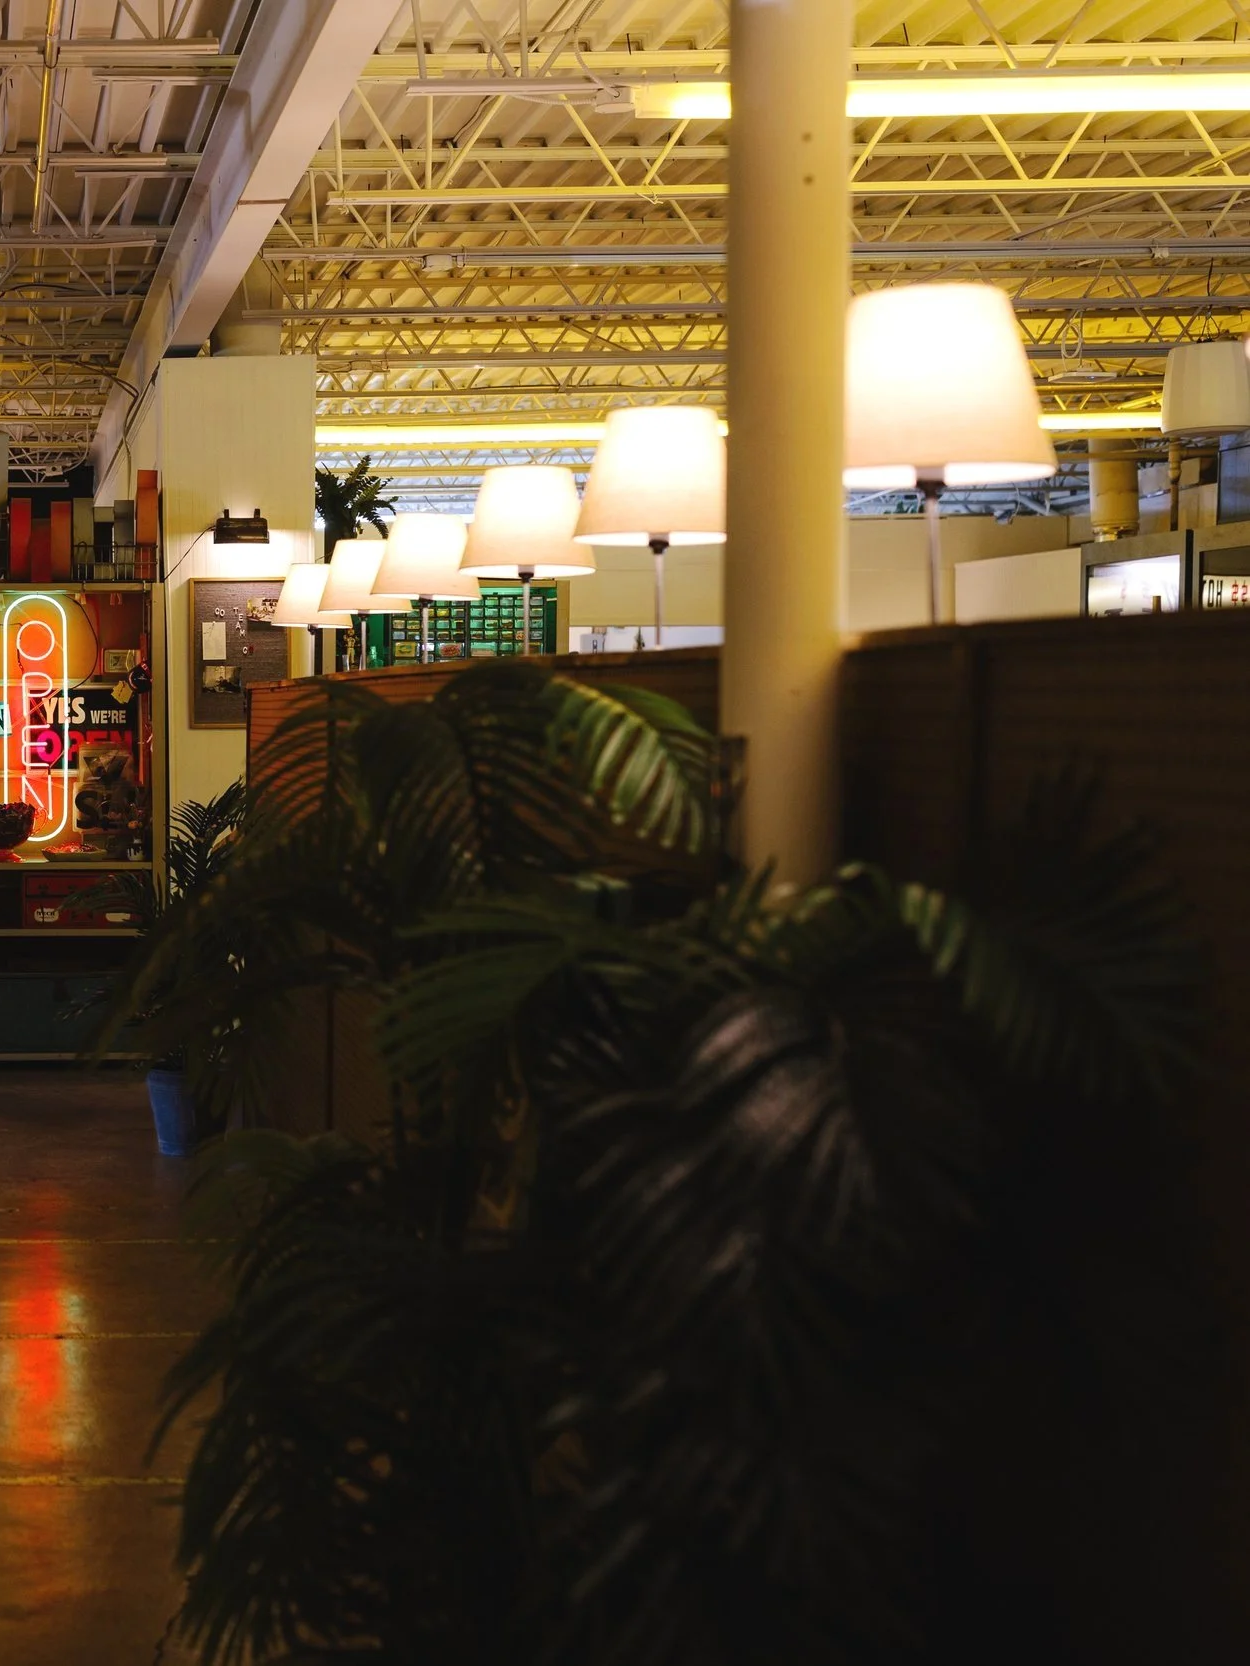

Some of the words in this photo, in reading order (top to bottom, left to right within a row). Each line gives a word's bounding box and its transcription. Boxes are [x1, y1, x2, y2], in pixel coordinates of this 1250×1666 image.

[16, 620, 55, 821] OPEN
[42, 696, 86, 725] YES
[90, 709, 127, 724] WE'RE
